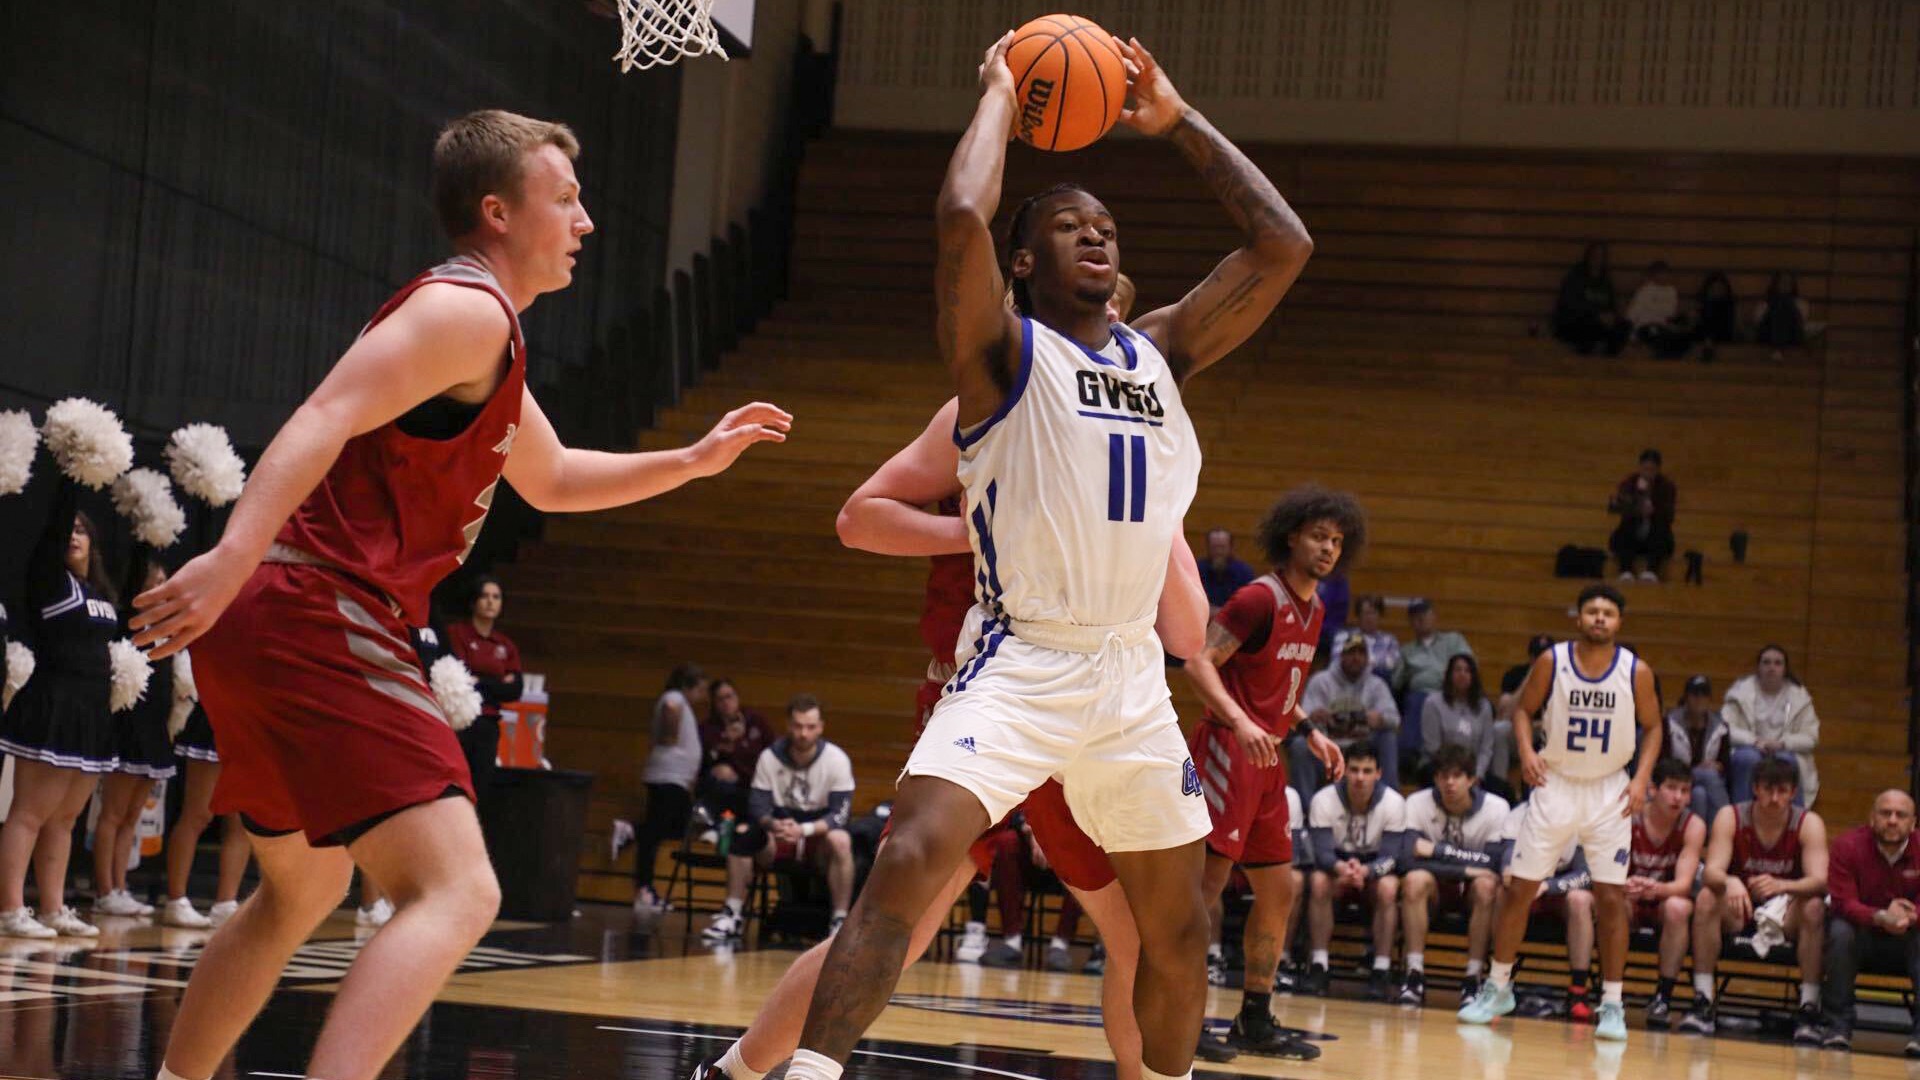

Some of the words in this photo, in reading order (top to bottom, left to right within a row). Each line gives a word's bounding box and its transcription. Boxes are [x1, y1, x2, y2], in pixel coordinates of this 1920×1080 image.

[1075, 369, 1164, 417] GVSU
[1108, 433, 1147, 523] 11
[1569, 689, 1616, 709] GVSU
[1566, 715, 1612, 754] 24
